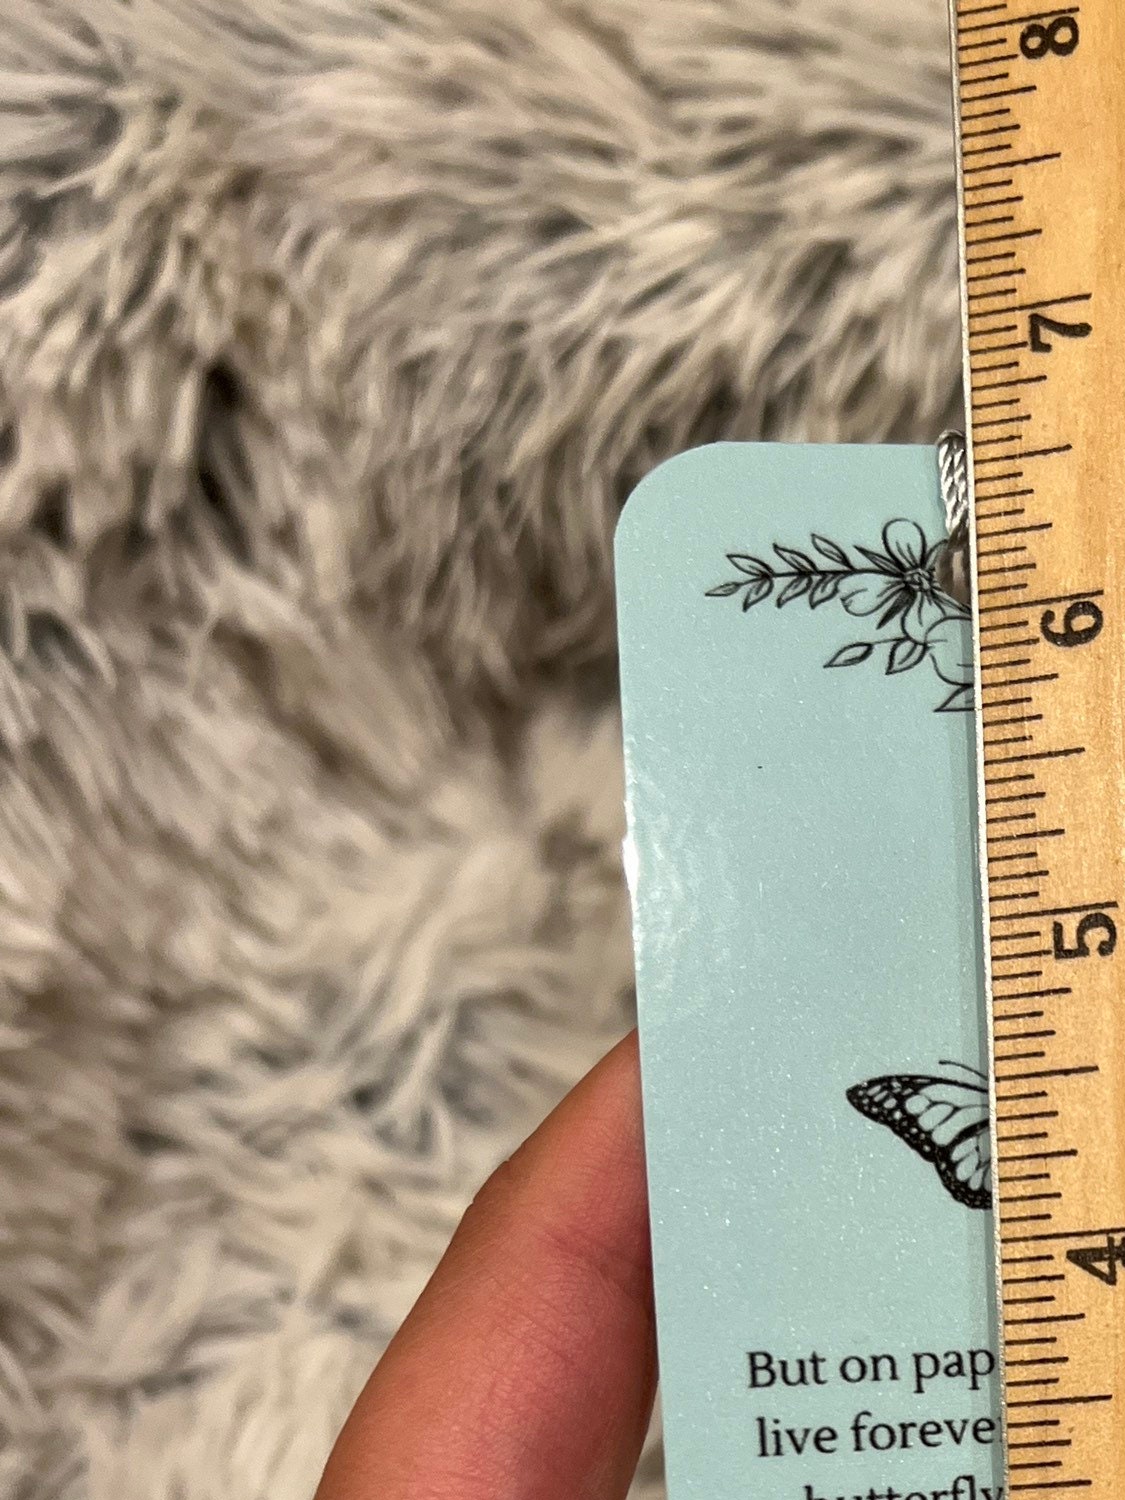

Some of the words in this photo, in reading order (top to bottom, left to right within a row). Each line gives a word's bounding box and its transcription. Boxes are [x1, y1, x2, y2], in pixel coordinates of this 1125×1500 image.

[1020, 15, 1080, 60] 8
[1028, 312, 1093, 354] 7
[1040, 600, 1104, 648] 6
[1053, 912, 1118, 961] 5
[746, 1350, 827, 1388] But
[839, 1355, 899, 1384] on
[756, 1416, 839, 1458] live
[851, 1411, 1003, 1453] foreve
